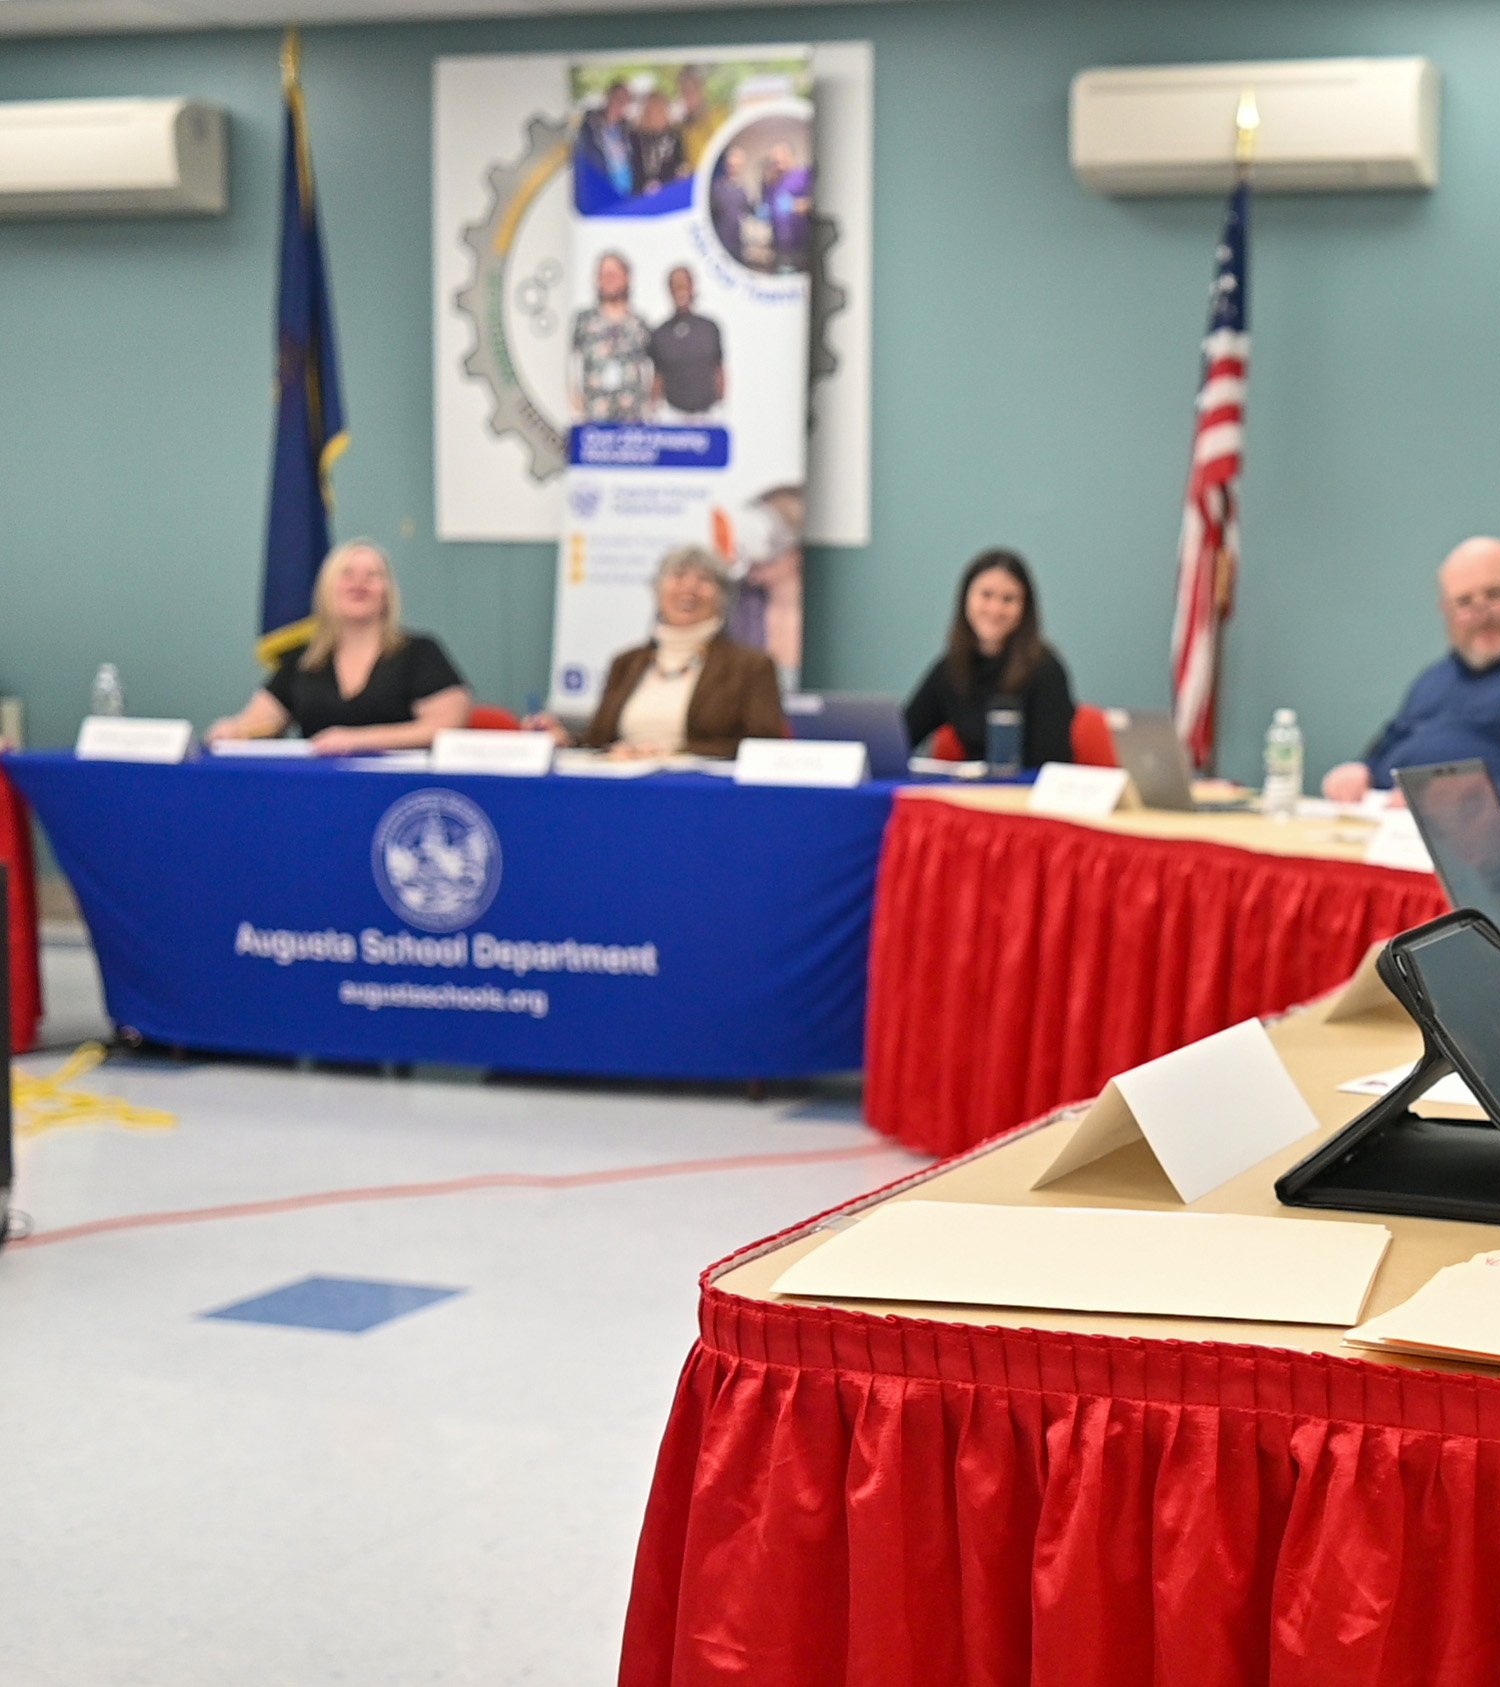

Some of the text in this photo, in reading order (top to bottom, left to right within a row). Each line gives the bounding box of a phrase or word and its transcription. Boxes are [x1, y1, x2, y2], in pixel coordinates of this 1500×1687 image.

[236, 922, 657, 975] Augusta School Department
